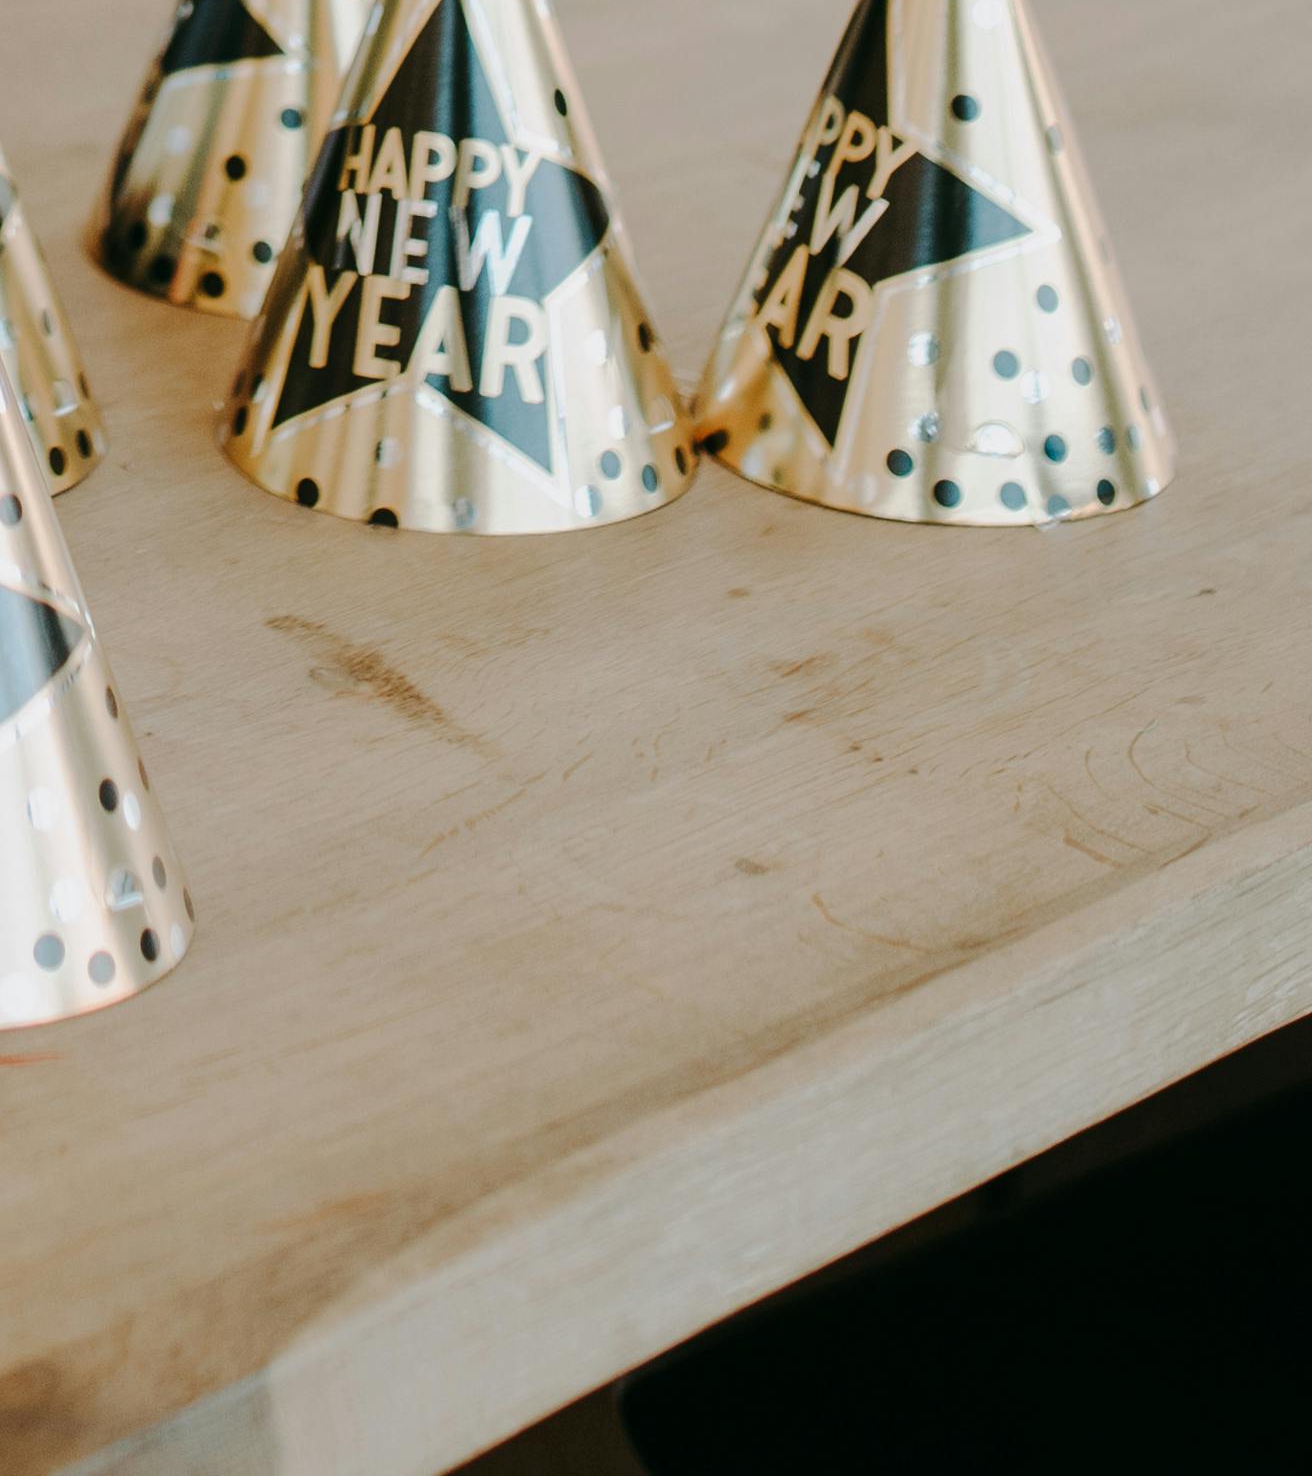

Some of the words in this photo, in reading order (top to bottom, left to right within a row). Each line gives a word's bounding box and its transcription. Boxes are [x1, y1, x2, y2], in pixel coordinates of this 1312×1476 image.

[337, 122, 542, 218] HAPPY
[800, 95, 921, 201] PPY
[334, 188, 533, 297] NEW
[774, 153, 891, 268] EW
[305, 263, 549, 404] YEAR
